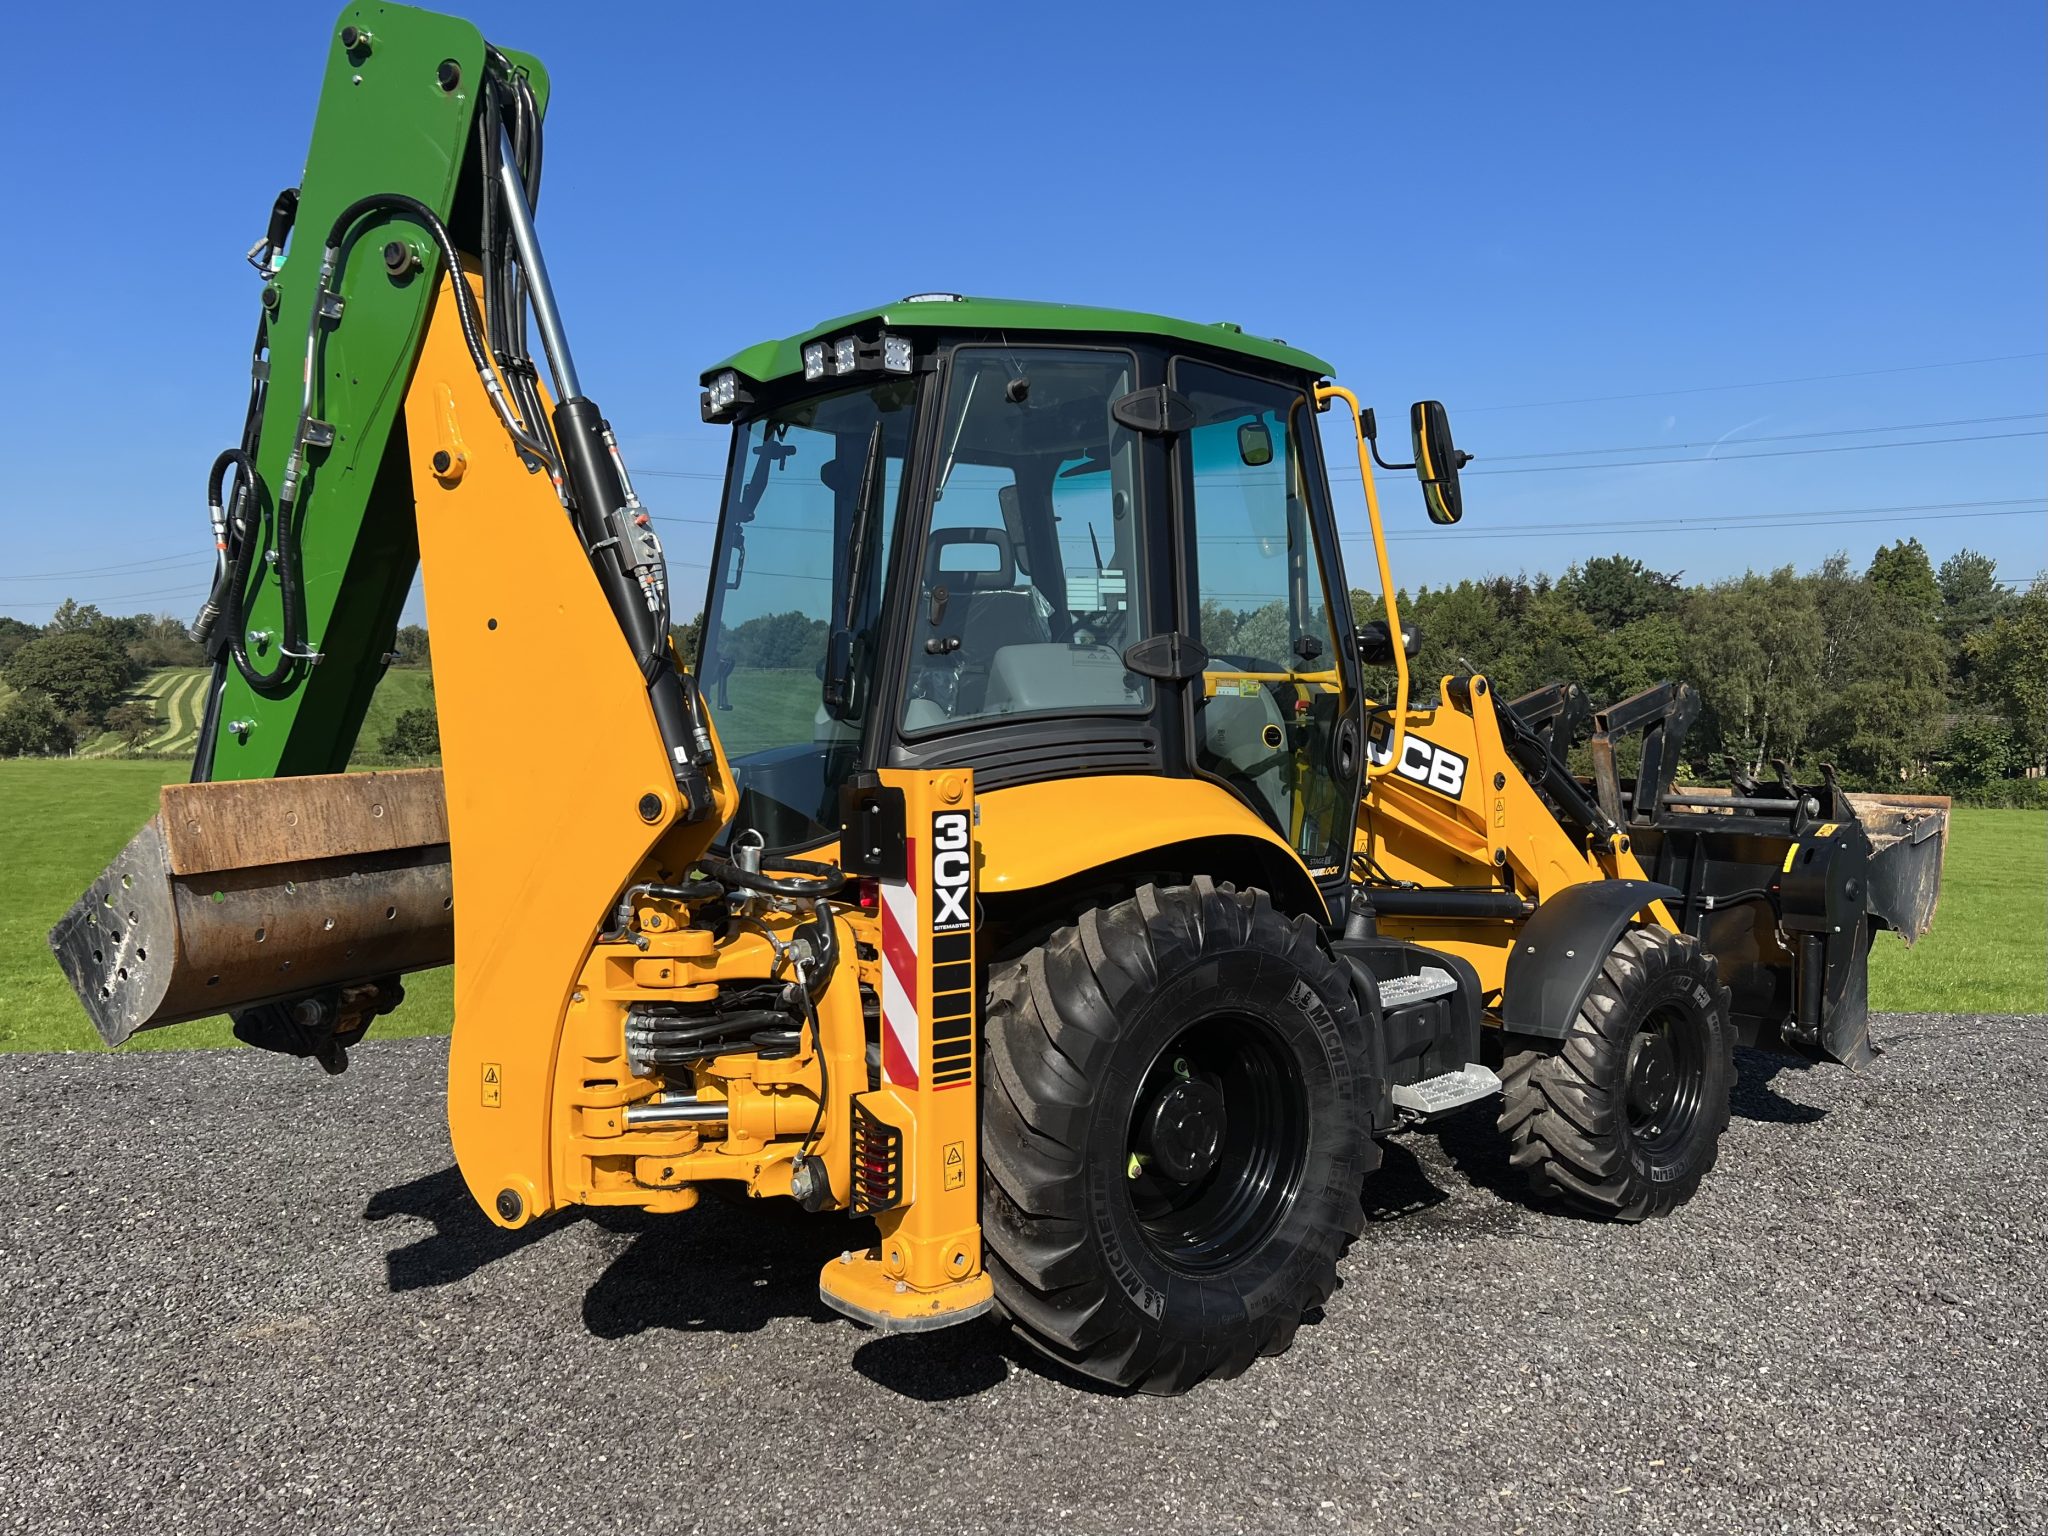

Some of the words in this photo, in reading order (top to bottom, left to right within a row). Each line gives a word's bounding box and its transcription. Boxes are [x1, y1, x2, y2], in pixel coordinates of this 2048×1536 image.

[1367, 728, 1465, 795] JCB
[934, 814, 970, 923] 3CX
[934, 922, 970, 931] SITEMASTER
[1653, 1156, 1691, 1181] ICHELIN
